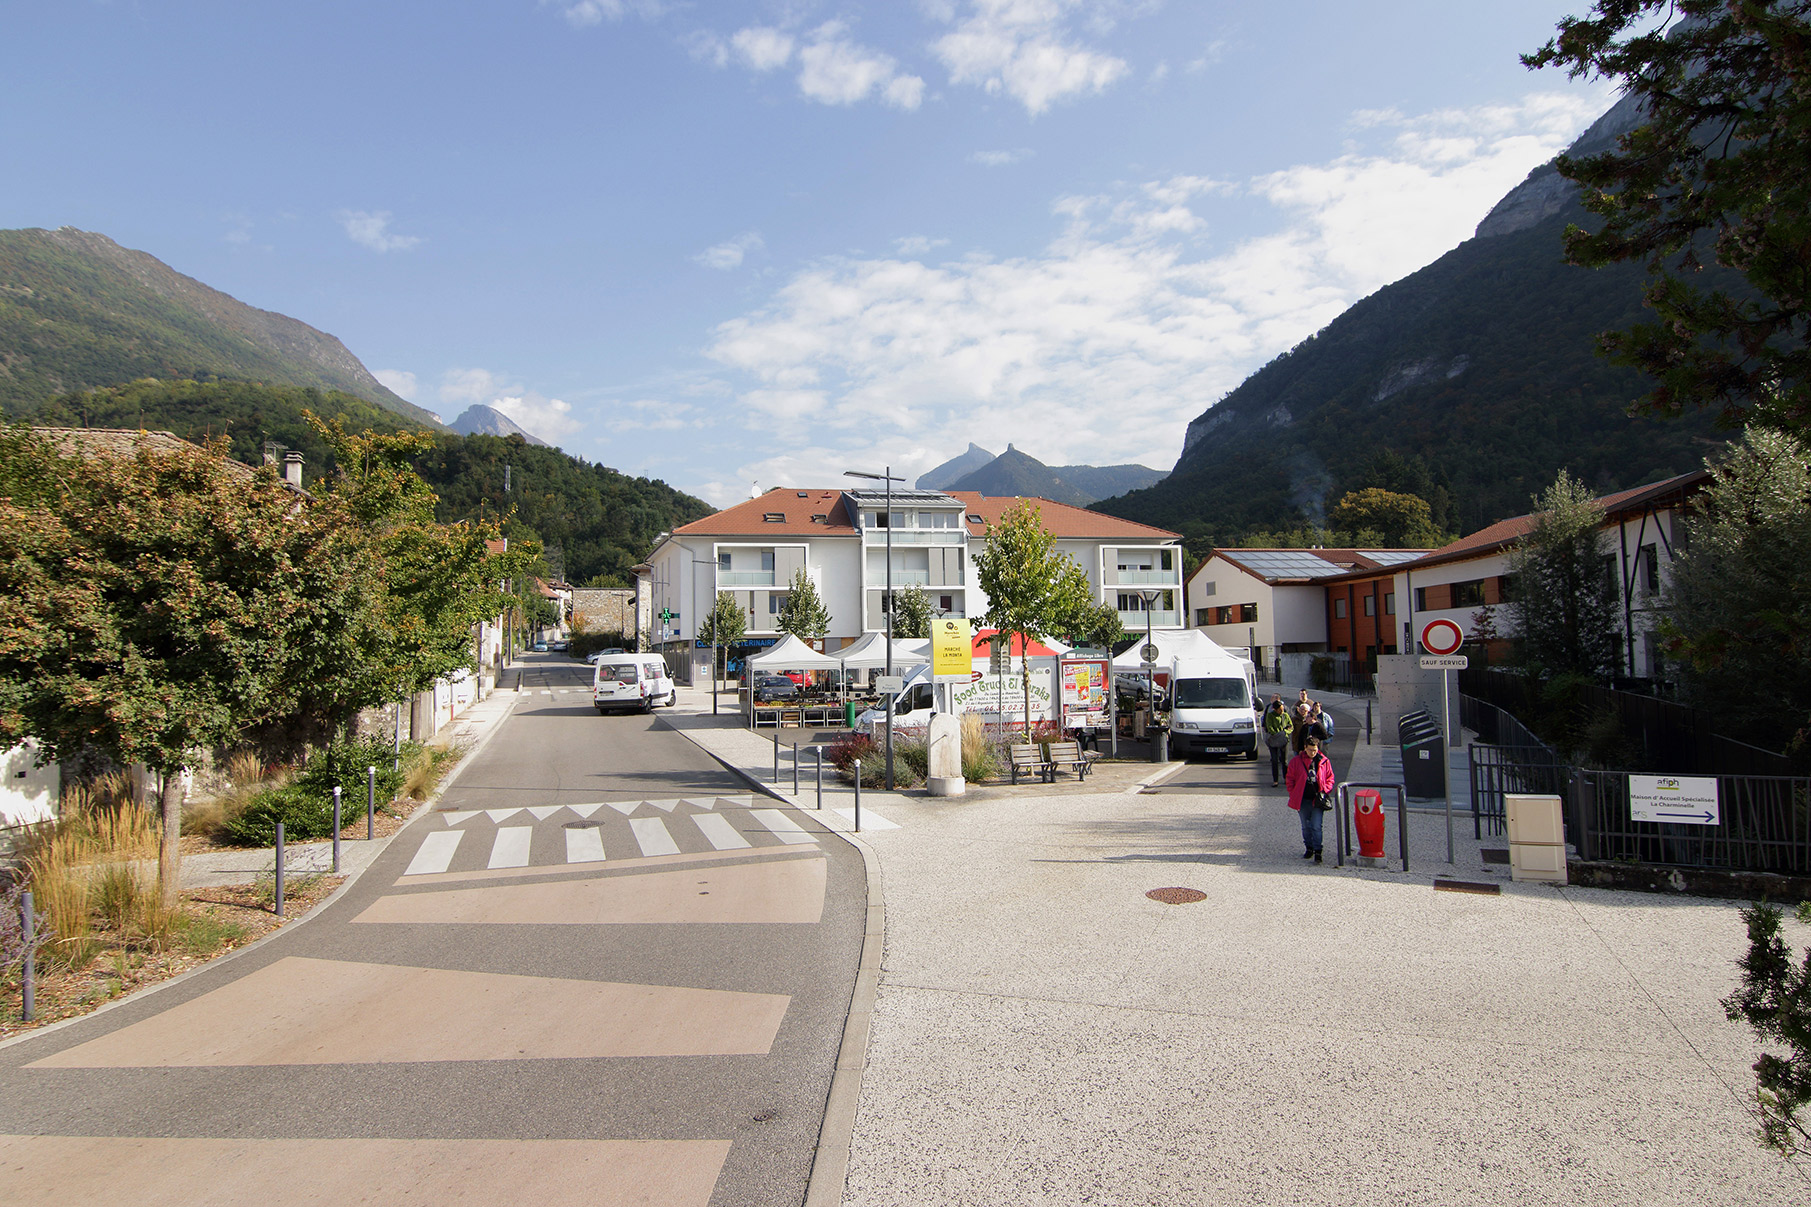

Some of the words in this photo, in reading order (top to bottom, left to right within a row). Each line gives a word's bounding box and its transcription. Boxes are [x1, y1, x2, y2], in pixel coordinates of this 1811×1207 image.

[953, 683, 977, 705] Food
[1008, 677, 1018, 690] El
[1657, 777, 1680, 787] afiph
